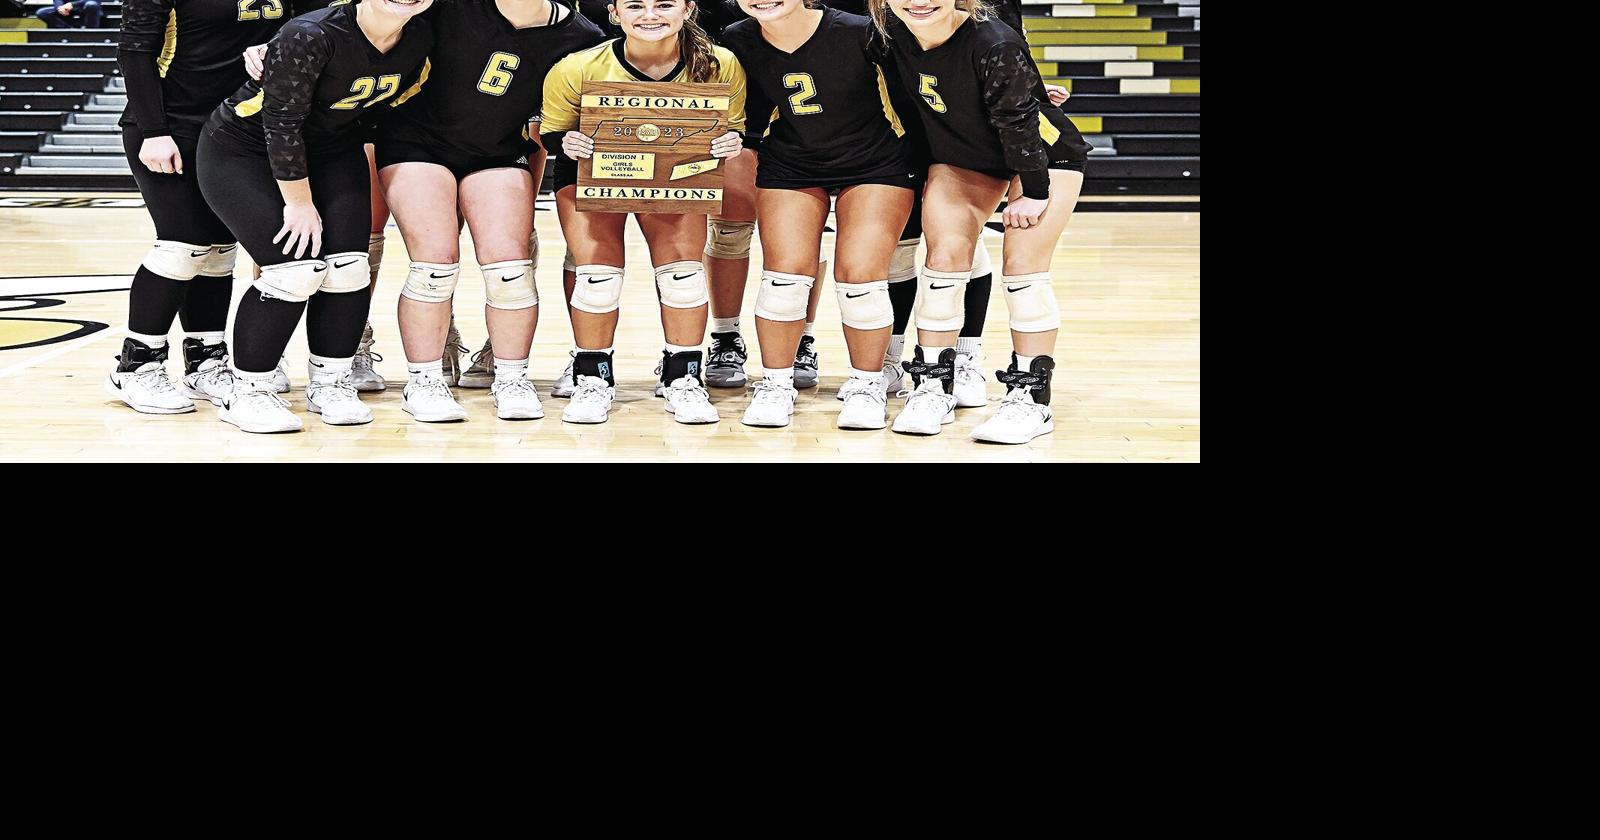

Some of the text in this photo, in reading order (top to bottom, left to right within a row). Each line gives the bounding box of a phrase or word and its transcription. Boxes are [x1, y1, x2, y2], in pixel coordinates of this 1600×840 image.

[329, 73, 401, 110] 27
[477, 51, 520, 96] 6
[598, 96, 714, 109] REGIONAL
[783, 72, 823, 115] 2
[919, 73, 947, 113] 5
[583, 187, 717, 200] CHAMPIONS
